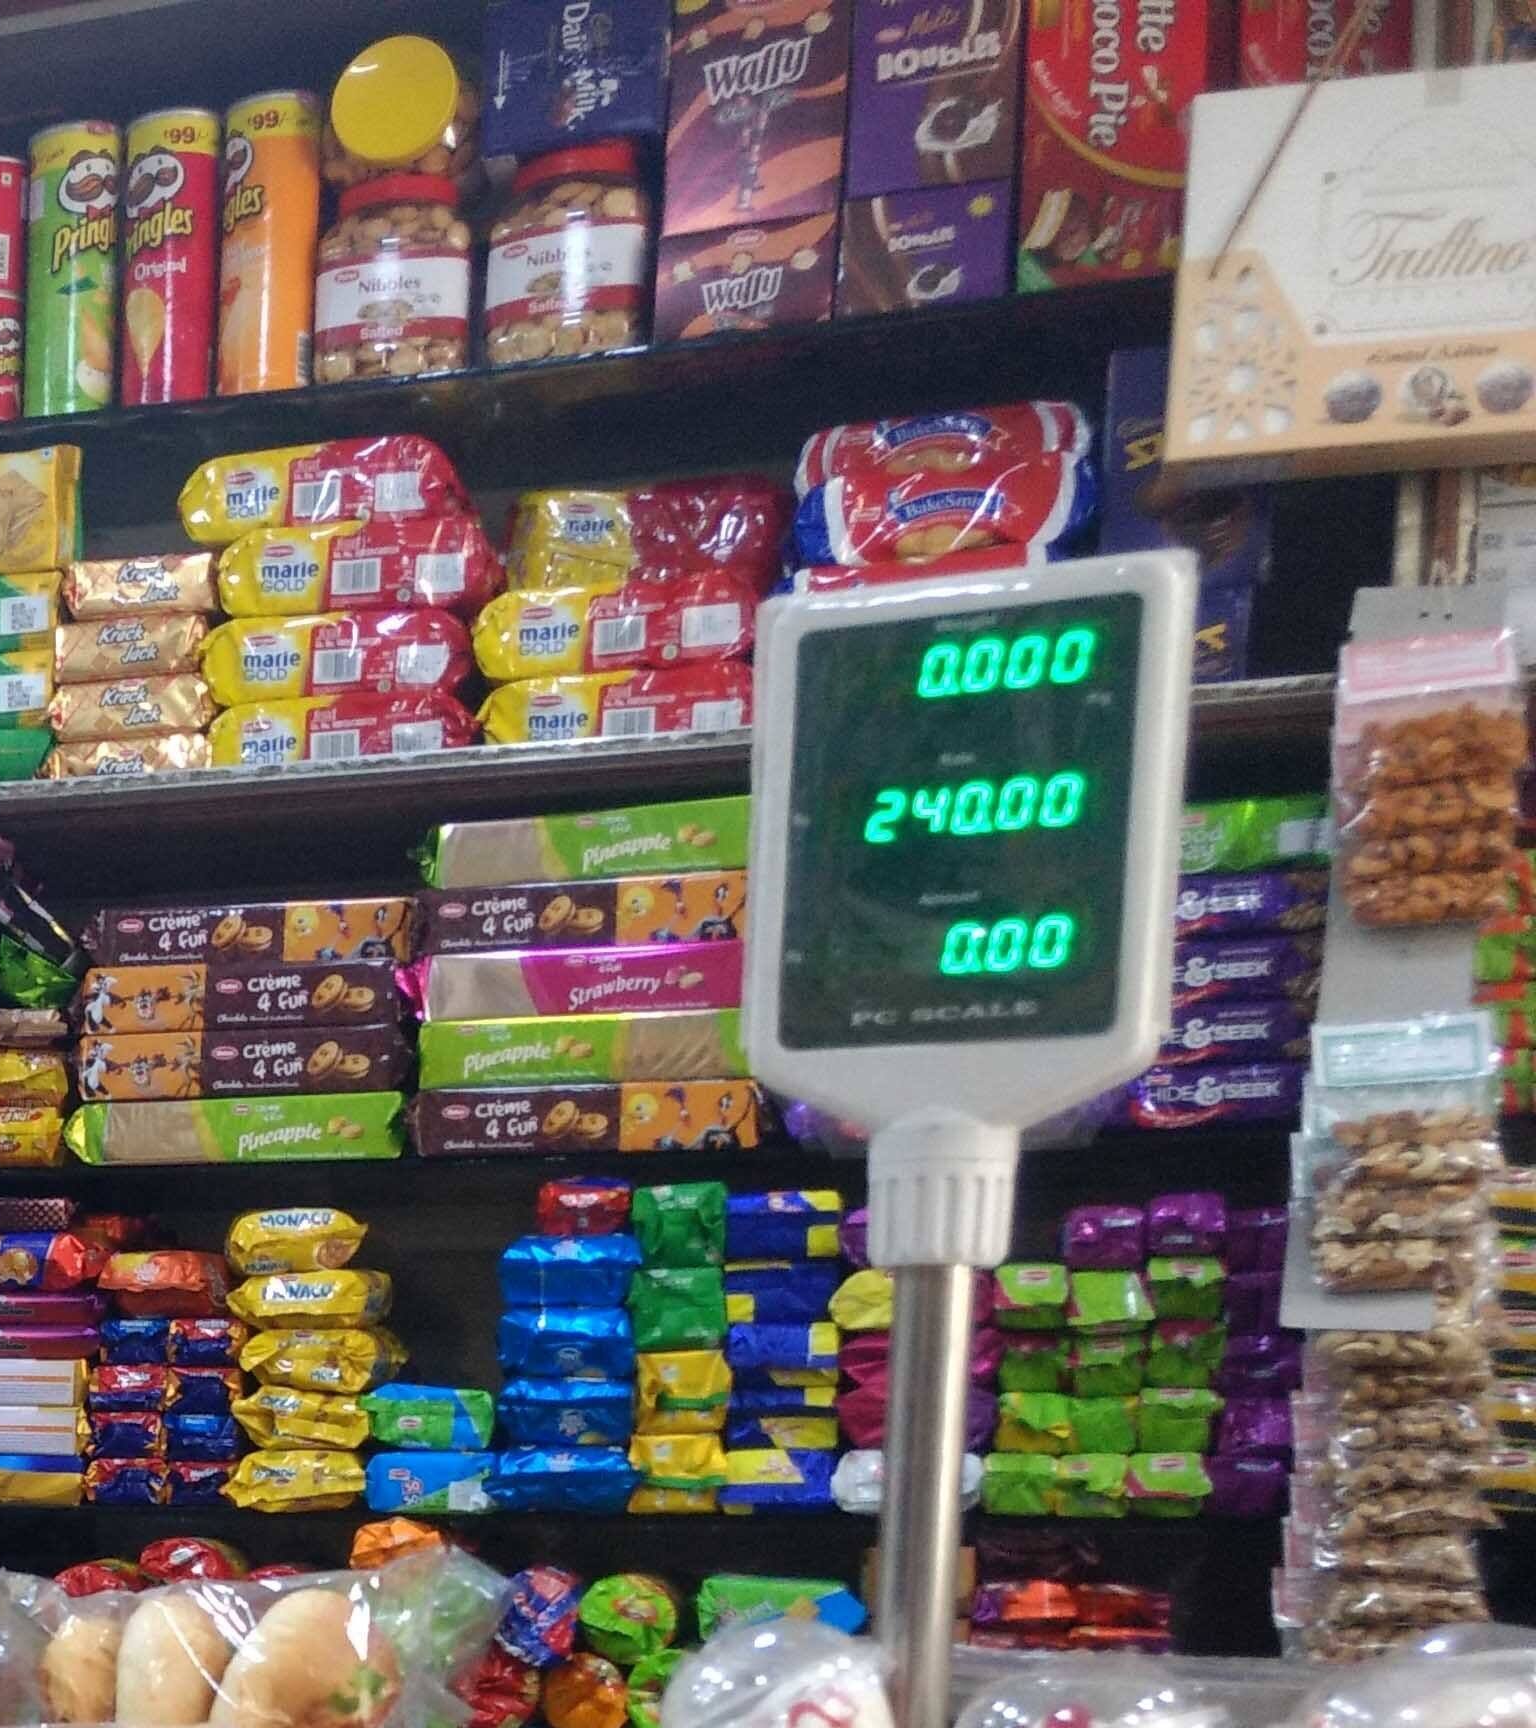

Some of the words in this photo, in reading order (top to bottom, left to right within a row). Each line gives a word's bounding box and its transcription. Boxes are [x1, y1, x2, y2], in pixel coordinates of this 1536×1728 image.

[1087, 79, 1130, 147] Pie
[224, 183, 263, 232] gles
[134, 256, 188, 281] Original
[357, 273, 422, 293] Nibbles
[359, 325, 405, 340] Salted
[228, 485, 280, 506] marie
[261, 560, 319, 579] marie
[261, 577, 305, 593] GOLD
[96, 625, 146, 647] Krack
[519, 622, 580, 642] marie
[121, 643, 159, 665] Jack
[519, 640, 566, 656] GOLD
[243, 649, 302, 669] marie
[243, 667, 287, 682] GOLD
[100, 688, 149, 709] Krack
[123, 706, 162, 727] Jack
[528, 711, 589, 730] marie
[241, 734, 297, 754] marie
[96, 757, 145, 777] Krack
[863, 771, 1088, 845] 240.00
[581, 832, 673, 870] Pineapple
[482, 917, 496, 936] 4
[157, 932, 171, 951] 4
[939, 913, 1075, 976] 0.00
[1183, 956, 1214, 987] &
[1213, 959, 1273, 981] SEEK
[256, 993, 270, 1012] 4
[568, 975, 662, 1011] Strawberry
[1182, 1017, 1213, 1050] &
[1212, 1021, 1271, 1041] SEEK
[252, 1060, 266, 1079] 4
[463, 1042, 552, 1077] Pineapple
[1146, 1083, 1195, 1104] HIDE
[1193, 1076, 1223, 1107] &
[1222, 1079, 1280, 1099] SEEK
[237, 1120, 323, 1153] Pineapple
[486, 1119, 499, 1139] 4
[259, 1210, 334, 1228] MONACO
